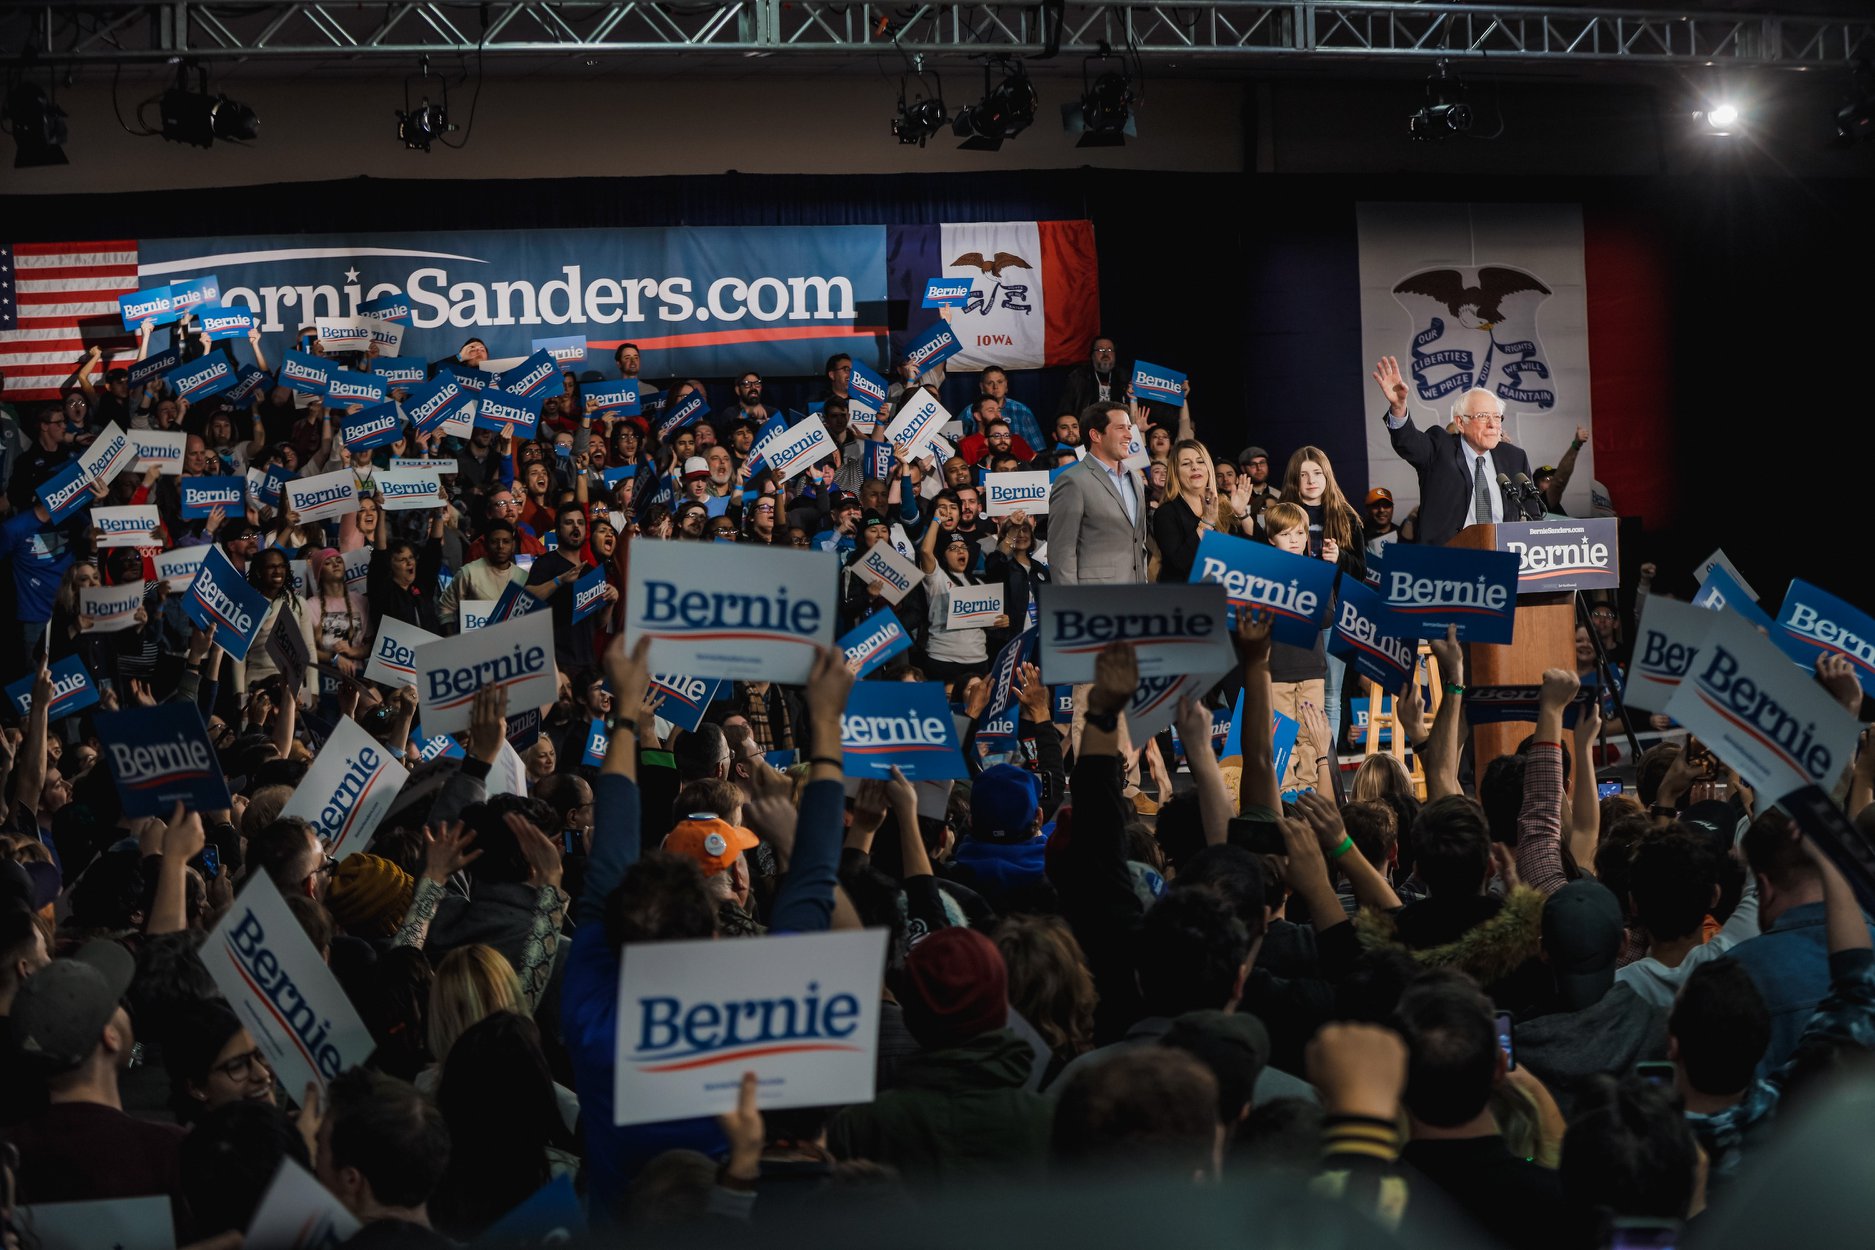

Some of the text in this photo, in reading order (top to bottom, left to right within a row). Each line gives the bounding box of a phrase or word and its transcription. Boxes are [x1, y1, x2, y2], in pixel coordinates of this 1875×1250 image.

[929, 285, 968, 298] Bernie
[123, 296, 170, 320] Bernie
[203, 314, 251, 330] Bernie
[321, 326, 368, 339] Bernie
[908, 331, 953, 366] Bernie
[977, 335, 1013, 347] IOWA
[1418, 329, 1438, 344] OUR
[1504, 342, 1533, 354] RIGHTS
[1414, 352, 1468, 371] LIBERTIES
[1503, 361, 1541, 374] WE WILL
[176, 362, 229, 393] Bernie
[329, 380, 382, 401] Bernie
[852, 370, 886, 402] Bernie
[1135, 370, 1183, 395] Bernie
[1421, 374, 1470, 400] WE PRIZE
[409, 383, 459, 425] Bernie
[1499, 385, 1550, 401] MAINTAIN
[481, 398, 535, 425] Bernie
[852, 409, 876, 422] Ber
[345, 414, 396, 441] Bernie
[88, 434, 126, 478] Bernie
[770, 428, 824, 469] Bernie
[185, 486, 240, 504] Bernie
[292, 483, 352, 509] Bernie
[381, 479, 438, 497] Bernie
[991, 484, 1046, 501] Bernie
[97, 516, 156, 532] Bernie
[1529, 526, 1585, 535] BernieSanders.com
[866, 551, 911, 592] Bernie
[197, 566, 252, 634] Bernie
[576, 579, 607, 608] Bernie
[1388, 571, 1507, 610] Bernie
[86, 594, 140, 617] Bernie
[641, 578, 821, 635] Bernie
[953, 597, 1001, 614] Bernie
[1053, 607, 1214, 641] Bernie
[1786, 602, 1875, 665] Bern
[378, 635, 417, 670] Ber
[845, 621, 900, 661] Bernie
[1641, 629, 1699, 675] Ber
[425, 643, 545, 701] Bernie
[1701, 644, 1832, 781] Bernie
[109, 732, 211, 779] Bernie
[230, 907, 342, 1081] Bernie
[636, 980, 860, 1052] Bernie
